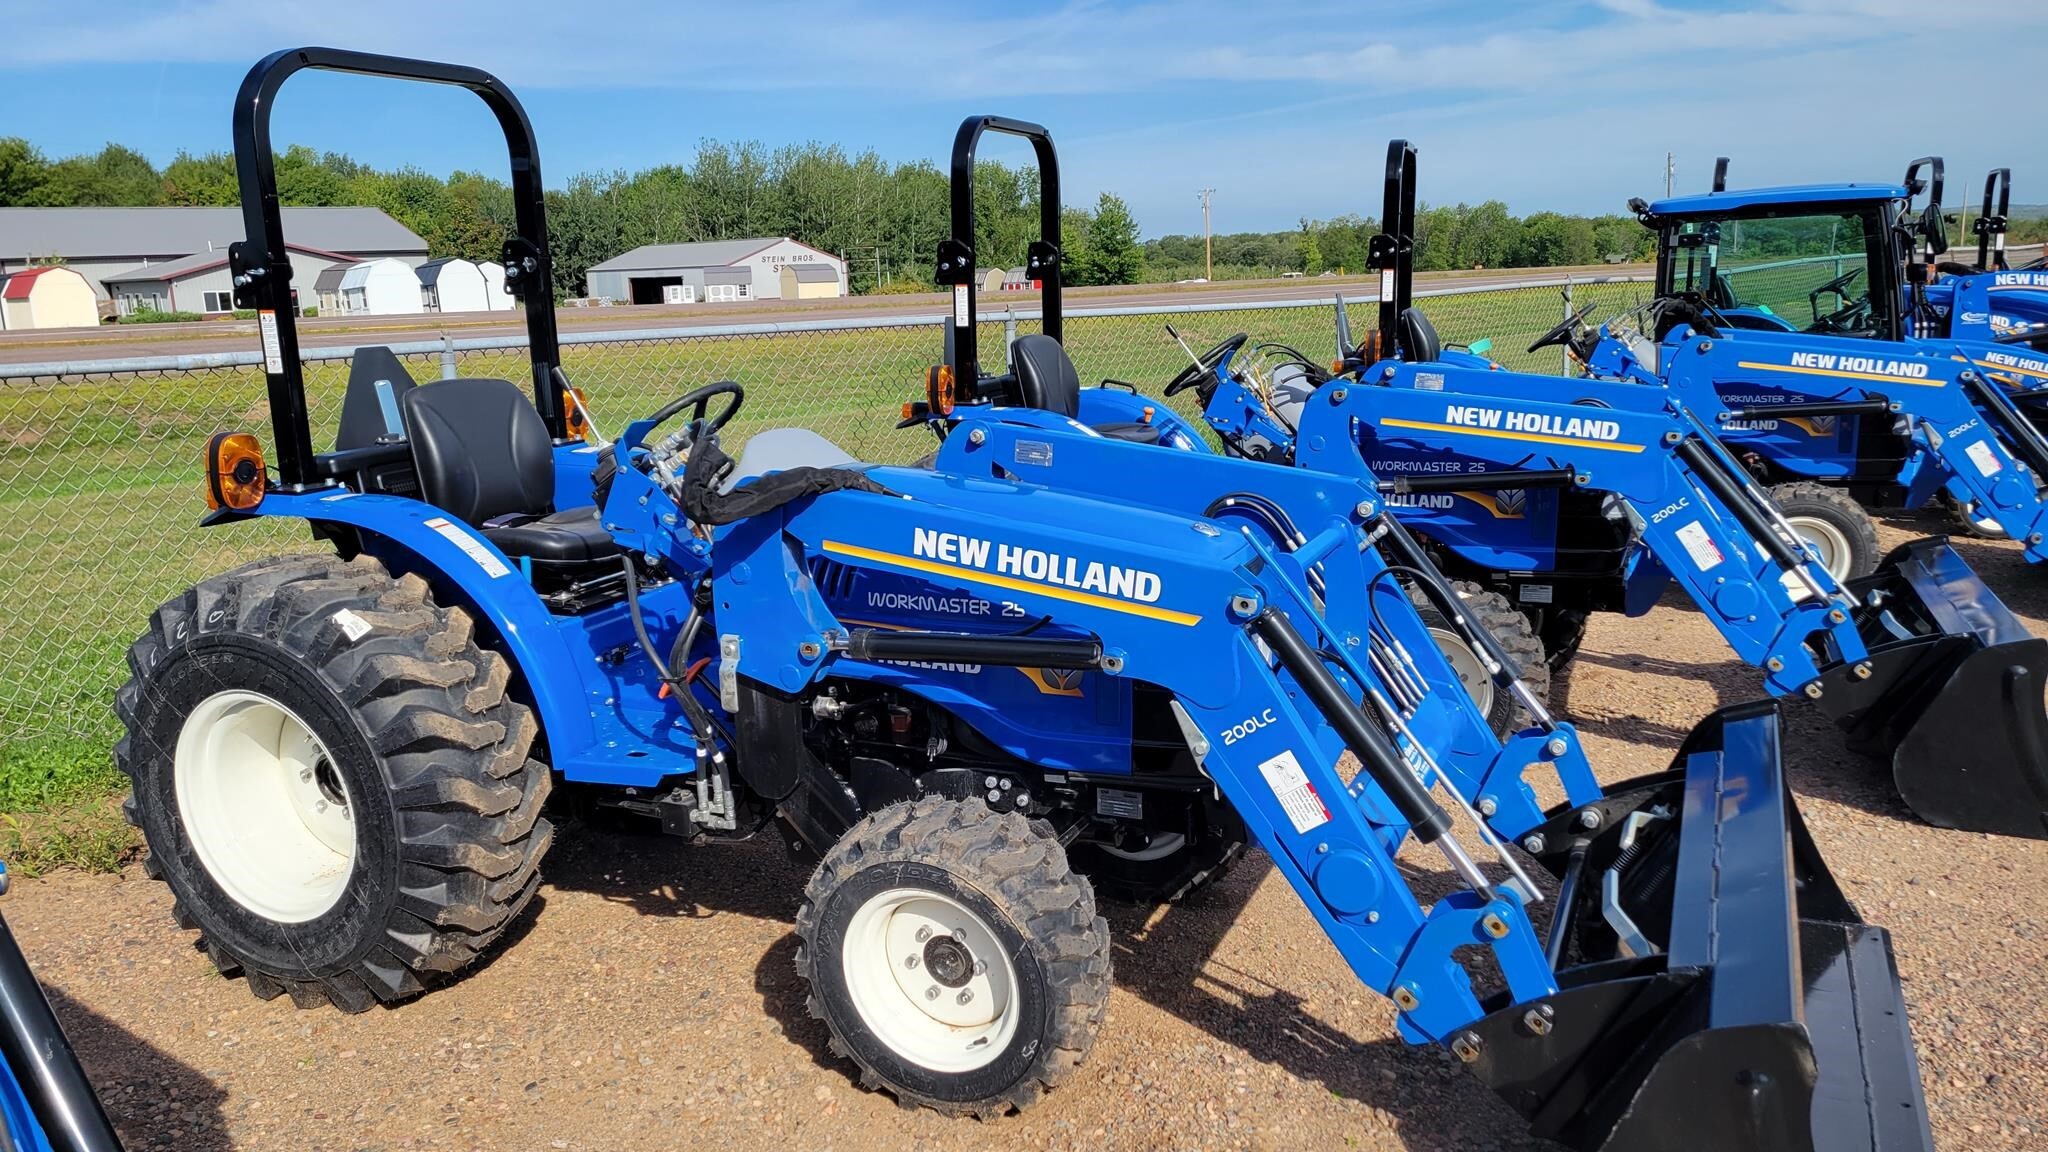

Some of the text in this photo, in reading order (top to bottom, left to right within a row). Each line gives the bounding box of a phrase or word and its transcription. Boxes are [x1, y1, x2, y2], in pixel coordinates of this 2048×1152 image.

[761, 255, 786, 264] STEIN
[1994, 273, 2031, 286] NEW
[1791, 352, 1928, 378] NEW HOLLAND
[1985, 351, 2018, 366] NEW
[1790, 395, 1805, 403] 25
[1446, 405, 1620, 441] NEW HOLLAND
[1721, 420, 1778, 430] OLLAND
[1947, 418, 1979, 439] 200LC
[1372, 460, 1486, 473] WORKMASTER 25
[1651, 496, 1690, 524] 200LC
[913, 527, 1162, 602] NEW HOLLAND
[867, 591, 1026, 617] WORKMASTER 25
[1220, 707, 1277, 746] 200LC
